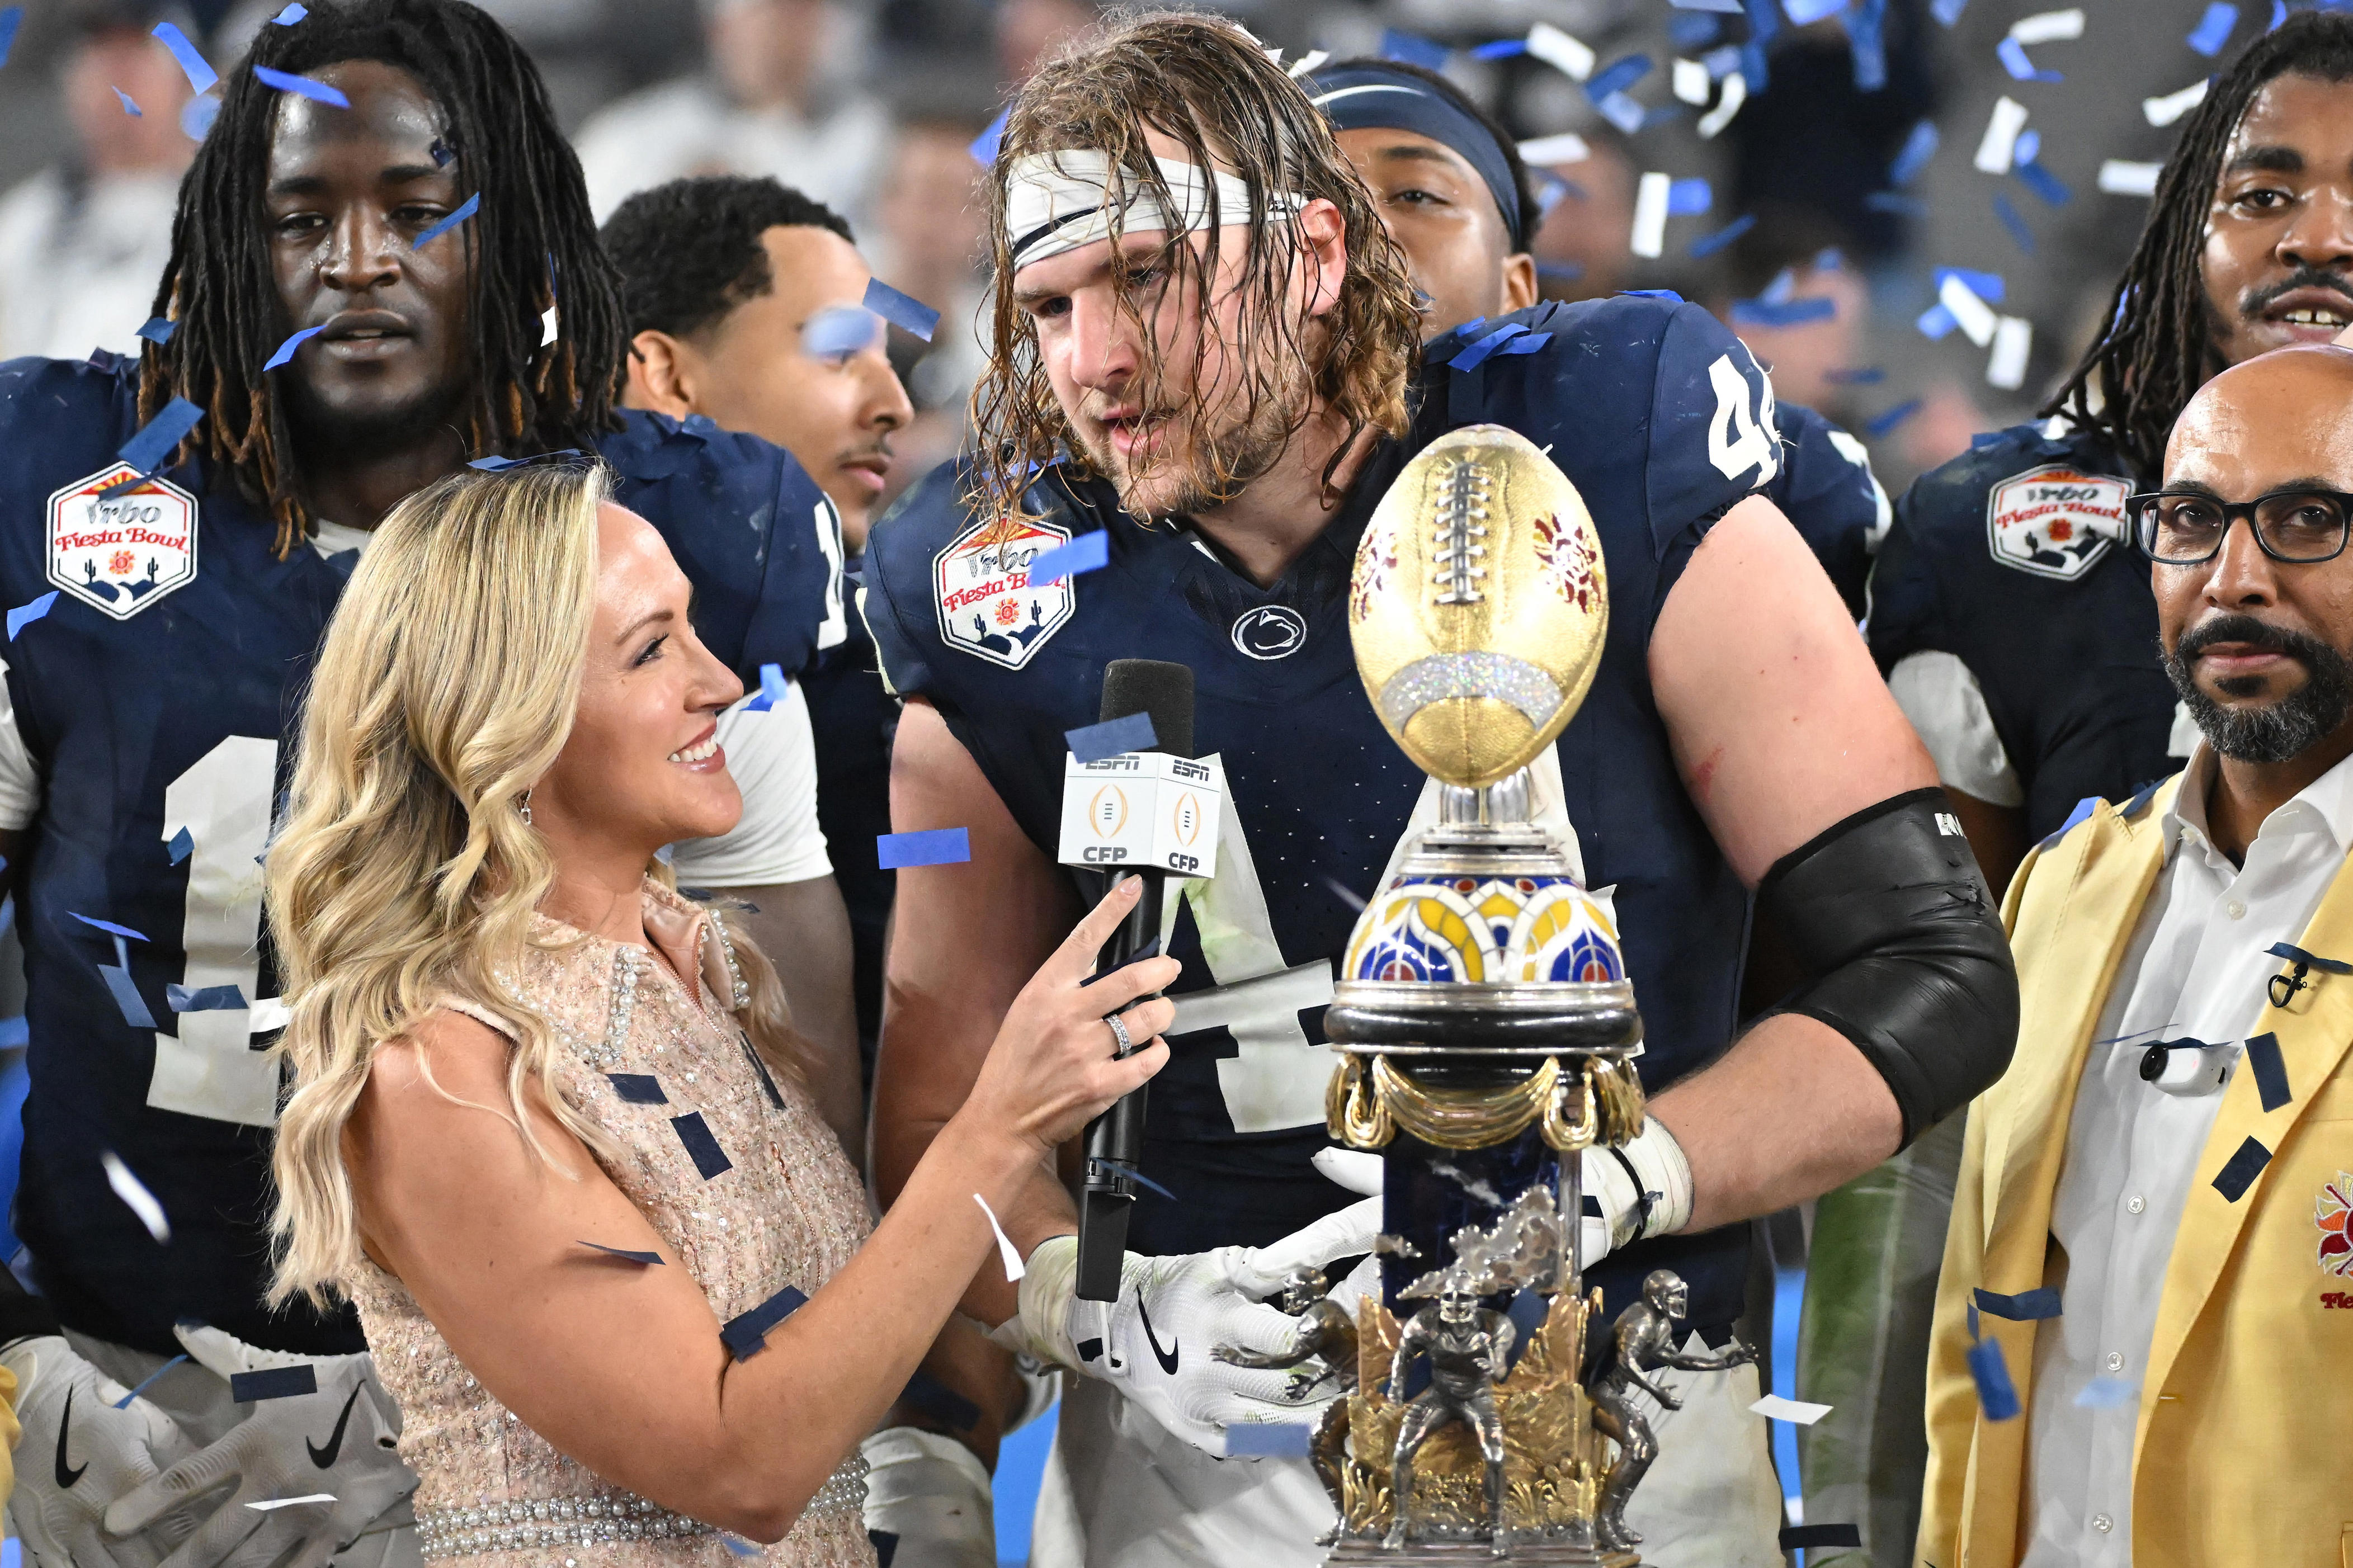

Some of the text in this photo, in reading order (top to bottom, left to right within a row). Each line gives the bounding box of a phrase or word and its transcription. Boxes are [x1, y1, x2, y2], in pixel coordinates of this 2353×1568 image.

[86, 500, 162, 524] Vrbo
[1996, 504, 2058, 528] Fiesta
[55, 528, 189, 552] Fiesta Bowl
[966, 546, 1039, 578] Vrbo
[943, 580, 1006, 613] Fiesta
[1172, 759, 1210, 782] ESPN
[1083, 846, 1128, 862] CFP
[1168, 852, 1199, 872] CFP
